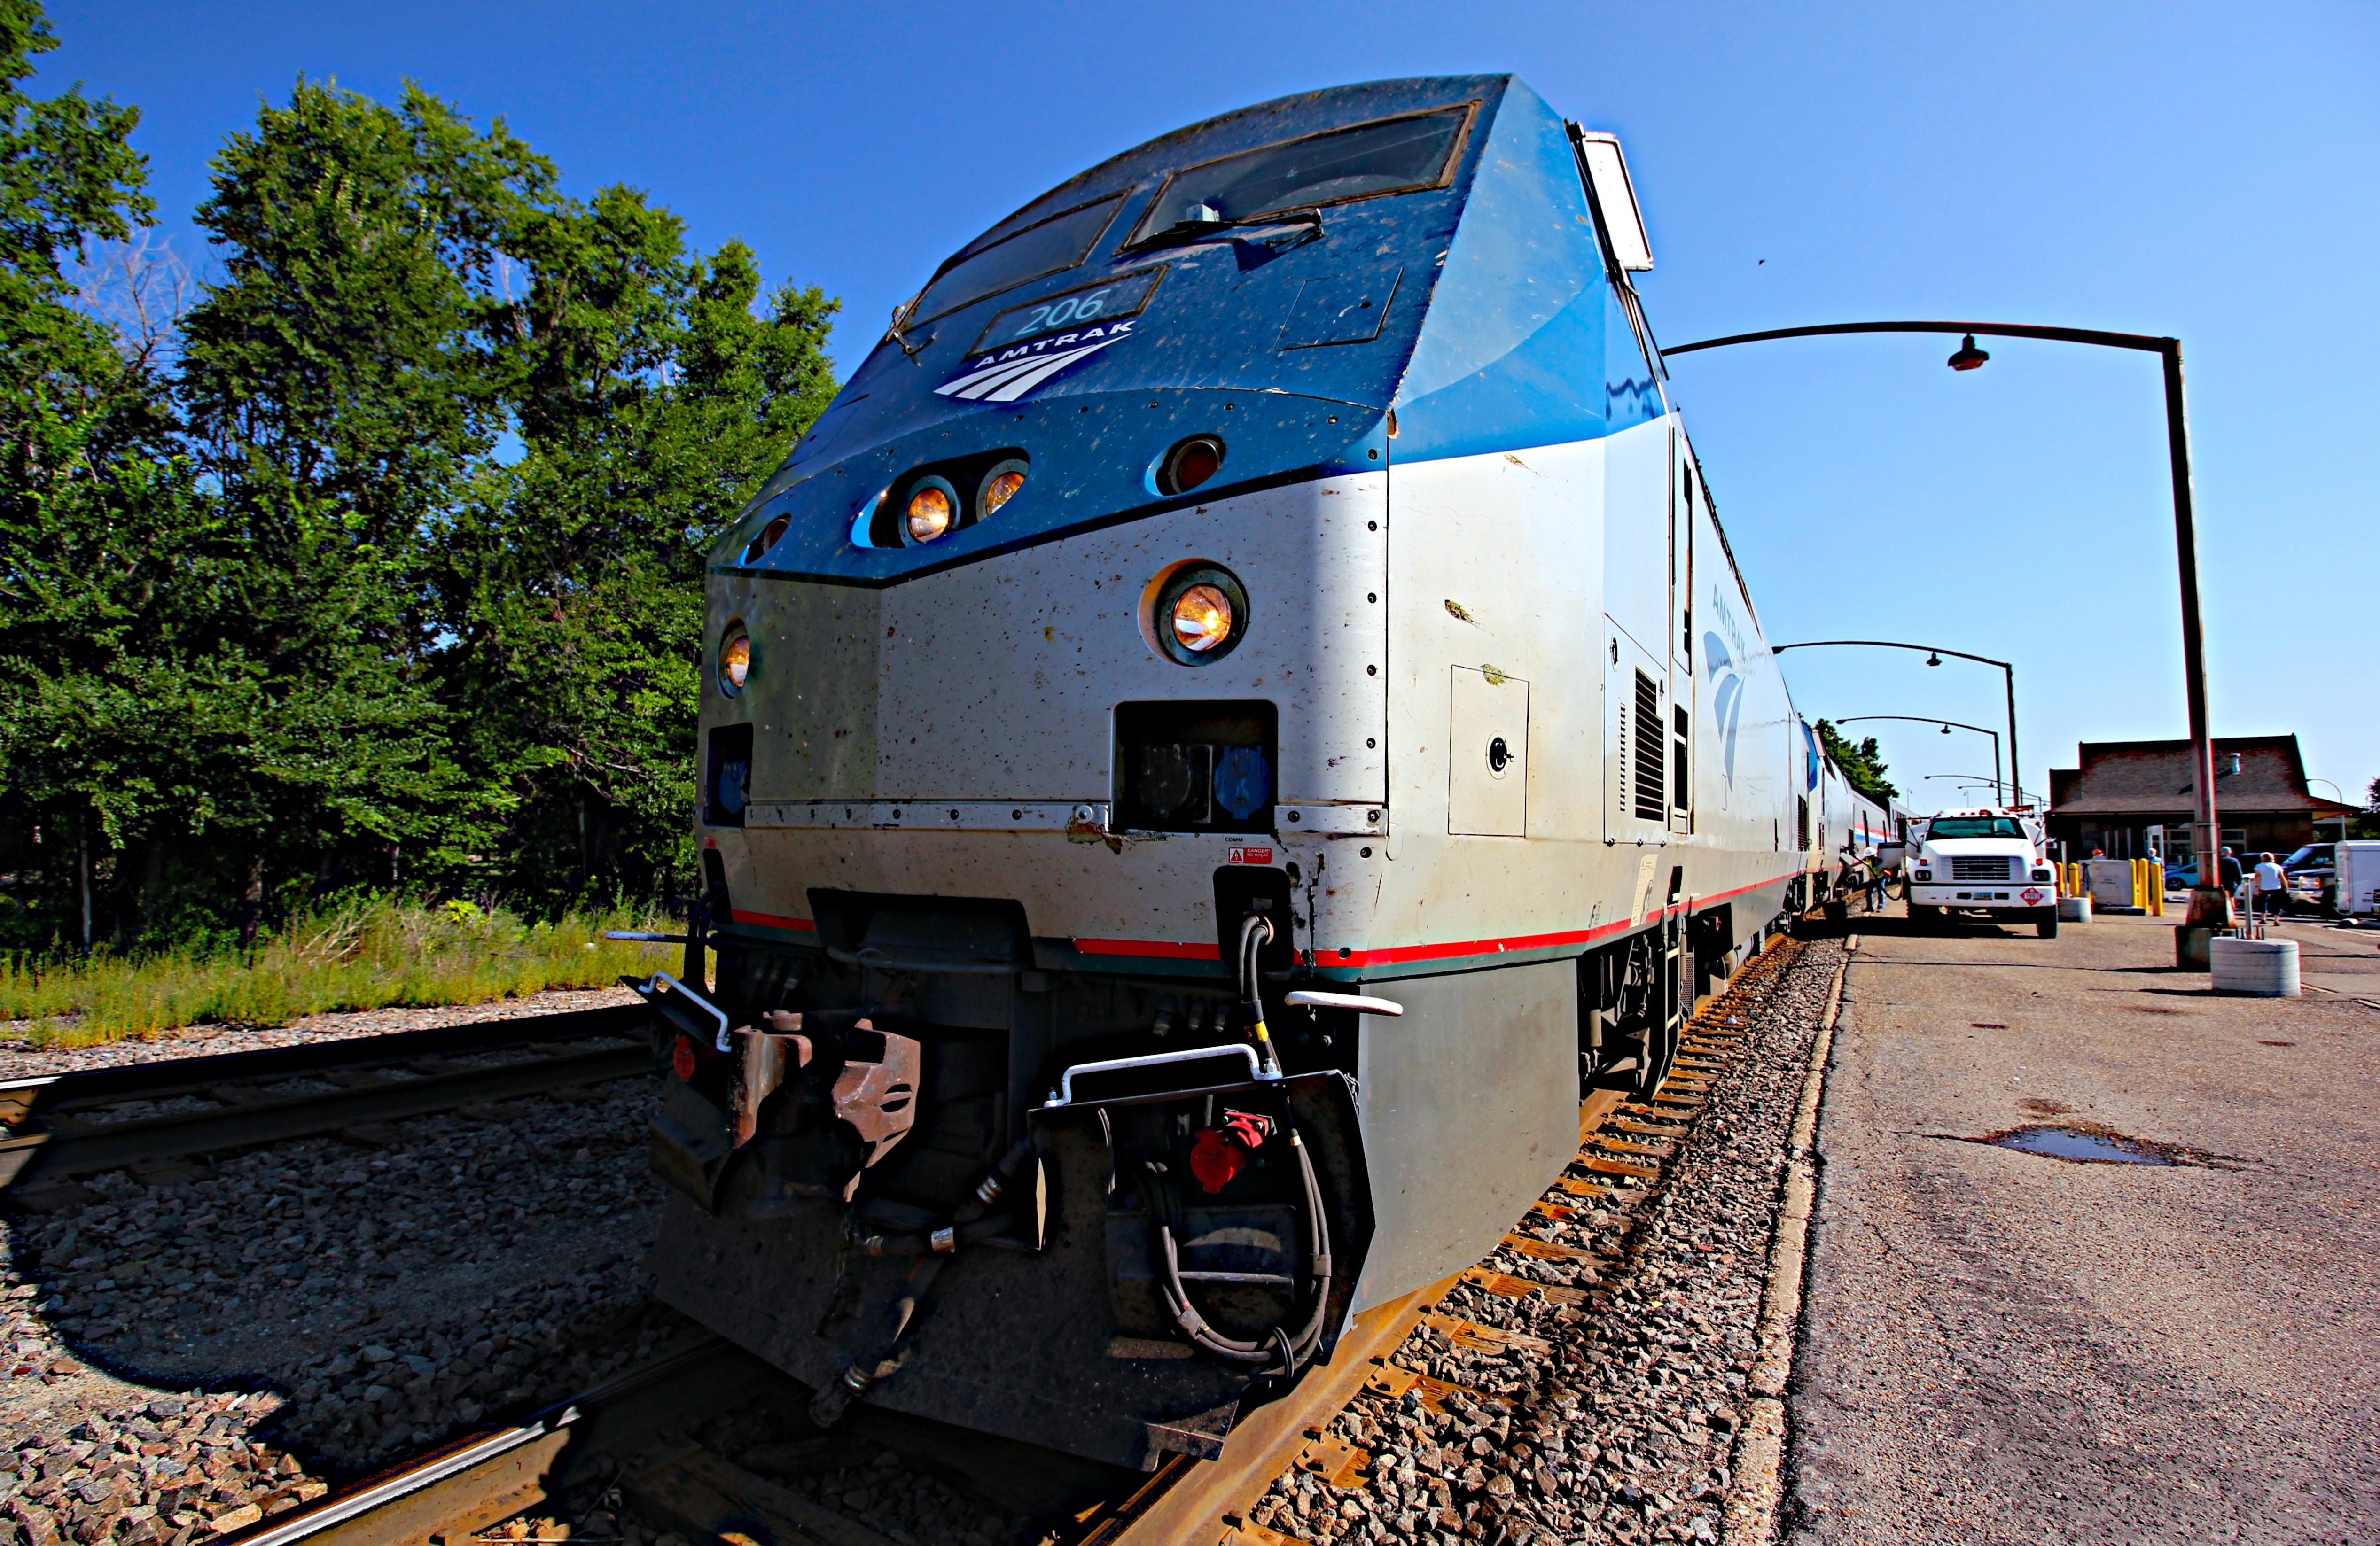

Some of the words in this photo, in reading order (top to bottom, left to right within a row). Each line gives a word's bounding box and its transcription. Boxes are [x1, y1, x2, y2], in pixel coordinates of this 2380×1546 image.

[1015, 289, 1111, 336] 206
[974, 320, 1136, 369] AMTRAK
[1713, 583, 1745, 664] AMTRAK
